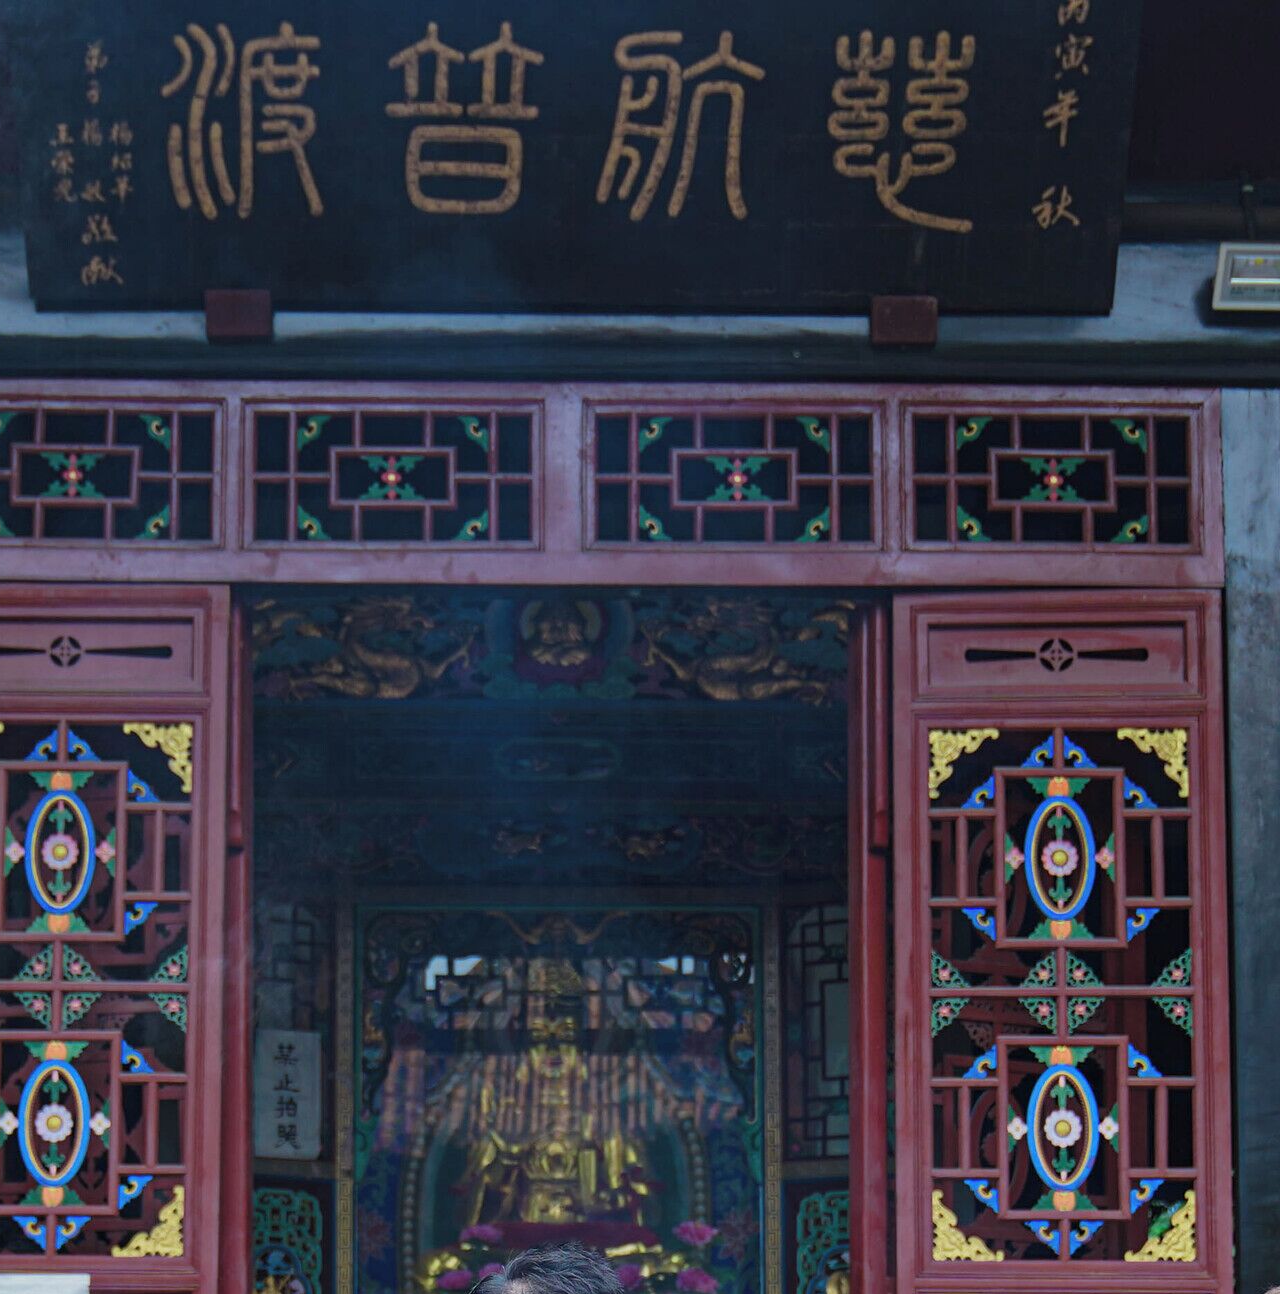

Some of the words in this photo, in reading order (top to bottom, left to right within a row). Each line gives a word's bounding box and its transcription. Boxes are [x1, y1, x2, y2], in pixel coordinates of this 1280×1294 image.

[161, 22, 976, 236] 慈航普渡
[273, 1042, 302, 1150] 禁止拍照
